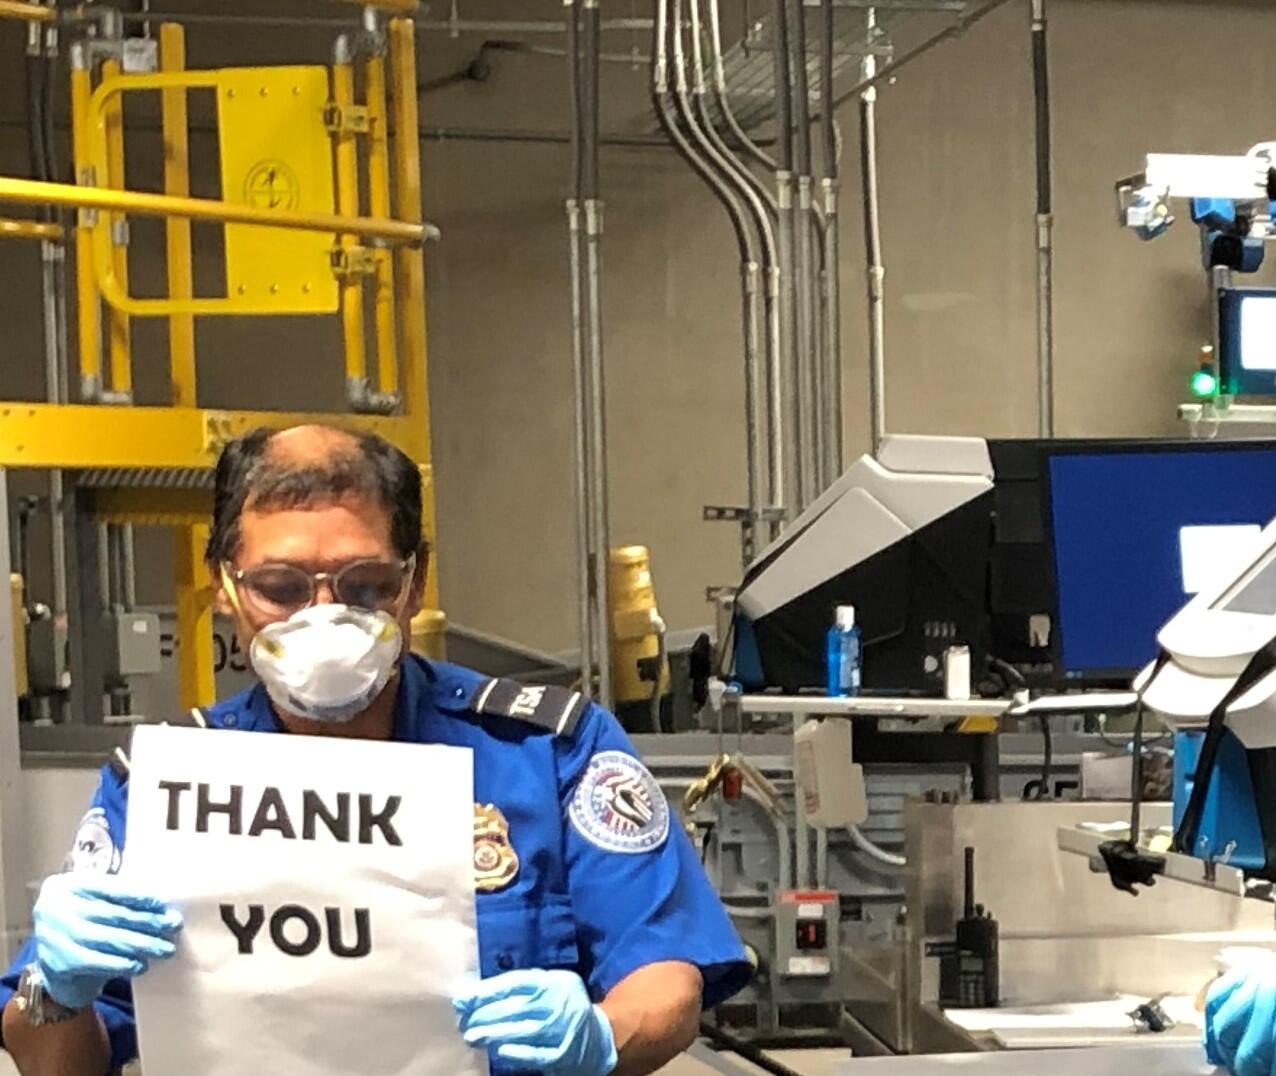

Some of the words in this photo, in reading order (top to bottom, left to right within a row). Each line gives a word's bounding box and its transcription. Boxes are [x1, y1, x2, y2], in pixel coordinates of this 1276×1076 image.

[508, 685, 547, 717] TSA
[158, 780, 404, 847] THANK
[219, 903, 373, 959] YOU
